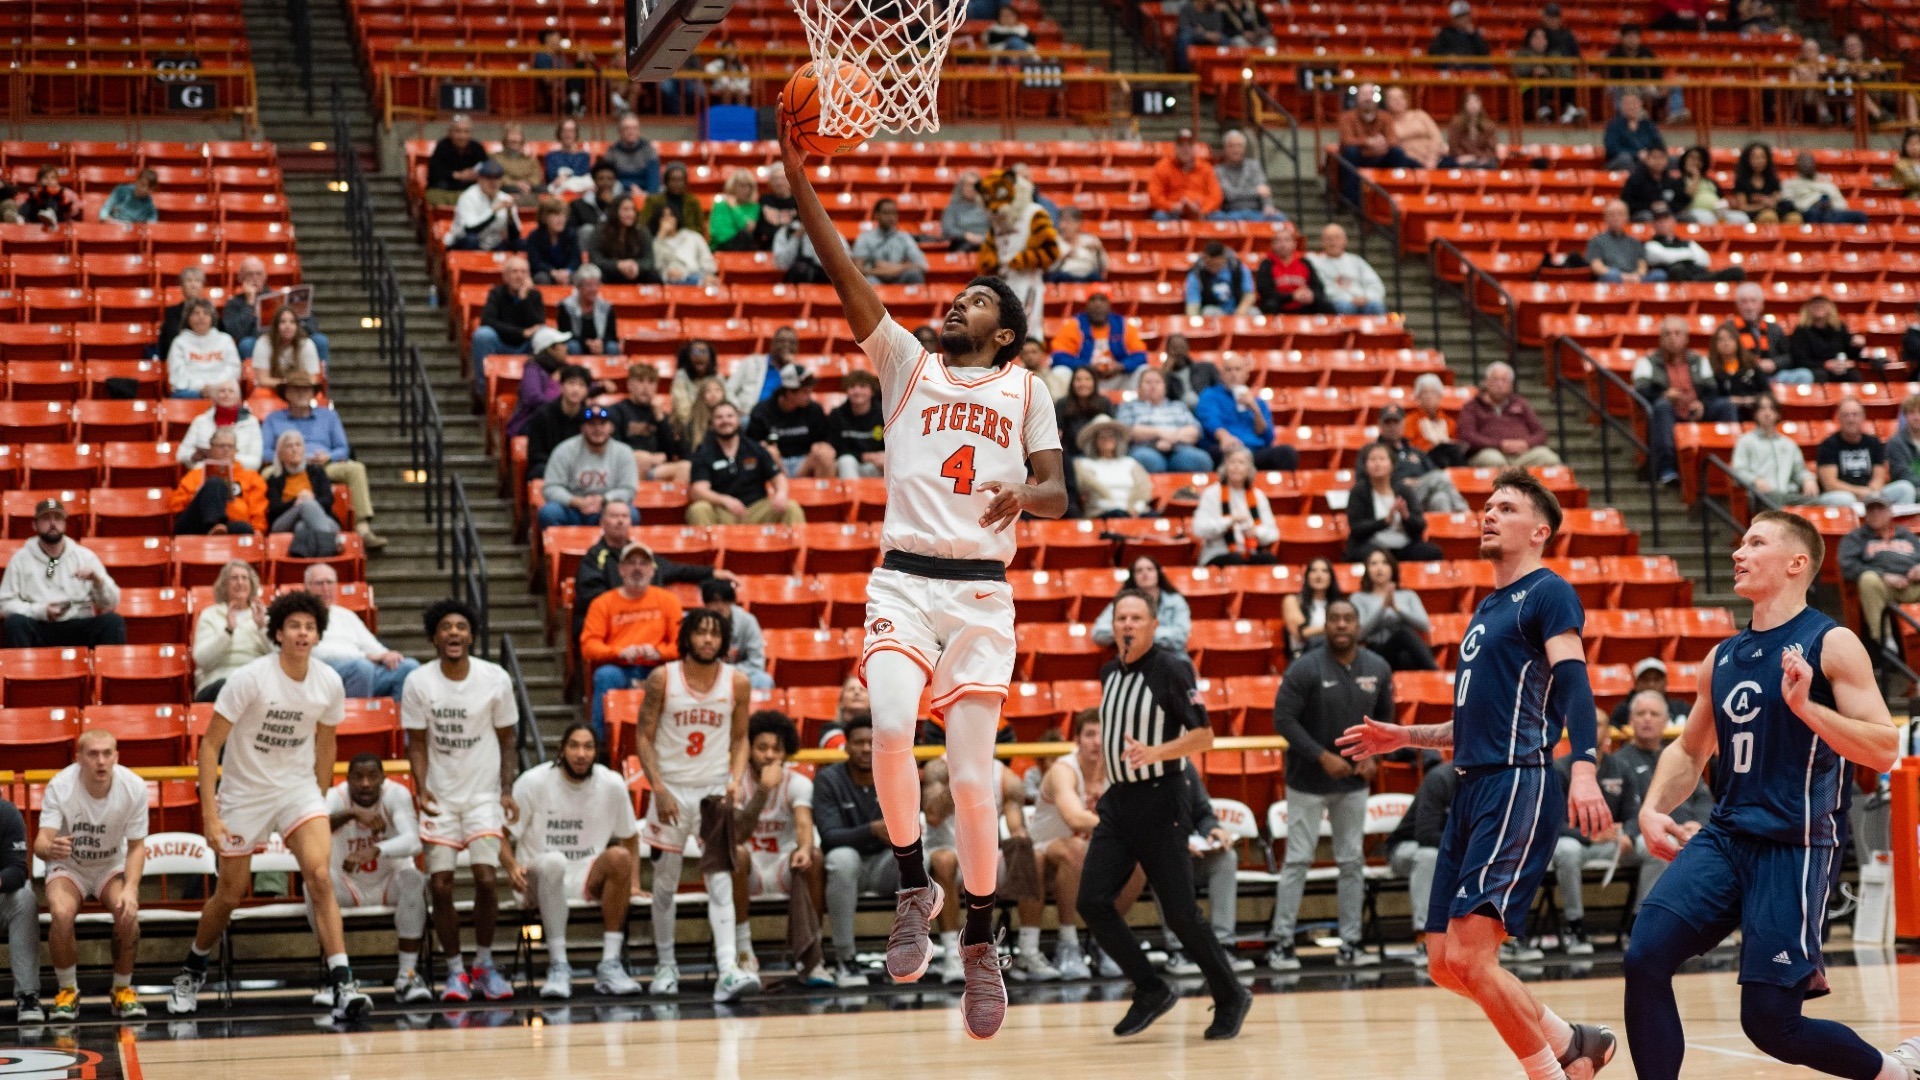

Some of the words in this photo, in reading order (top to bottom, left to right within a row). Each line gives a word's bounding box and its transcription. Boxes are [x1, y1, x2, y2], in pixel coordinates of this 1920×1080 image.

[181, 86, 203, 108] G
[453, 86, 473, 109] H
[921, 402, 1012, 448] TIGERS
[940, 444, 976, 495] 4
[1457, 668, 1472, 707] 0
[265, 709, 304, 722] PACIFIC
[673, 708, 723, 728] TIGERS
[262, 722, 295, 735] TIGERS
[686, 732, 705, 757] 3
[546, 819, 584, 830] PACIFIC
[144, 841, 205, 860] PACIFIC
[545, 834, 579, 846] TIGERS
